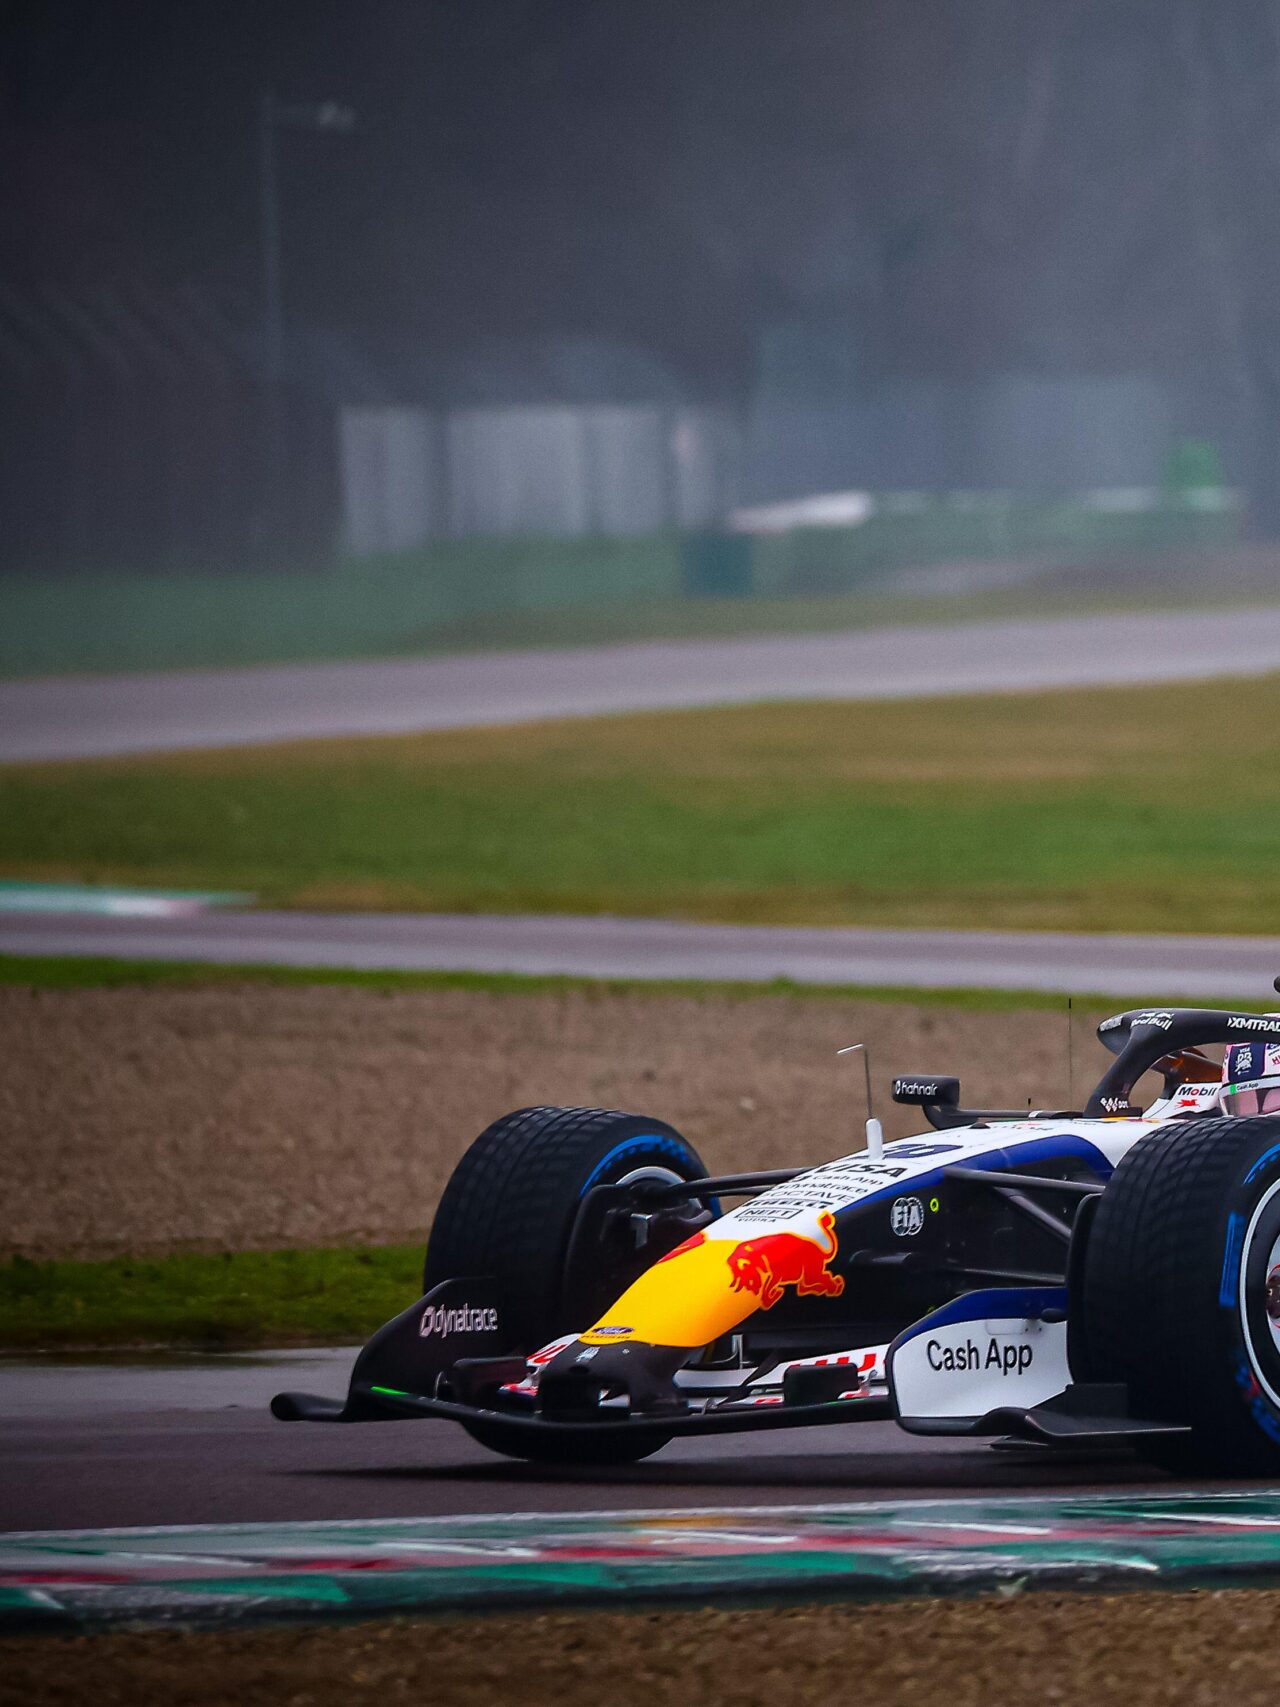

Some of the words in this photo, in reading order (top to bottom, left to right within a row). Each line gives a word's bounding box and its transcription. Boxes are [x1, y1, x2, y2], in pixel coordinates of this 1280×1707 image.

[902, 1081, 938, 1096] hahnair
[1178, 1086, 1218, 1096] Mobil
[814, 1163, 908, 1178] VISA
[851, 1176, 883, 1187] App
[433, 1303, 498, 1338] dynatrace
[927, 1339, 980, 1371] Cash
[985, 1338, 1033, 1376] App
